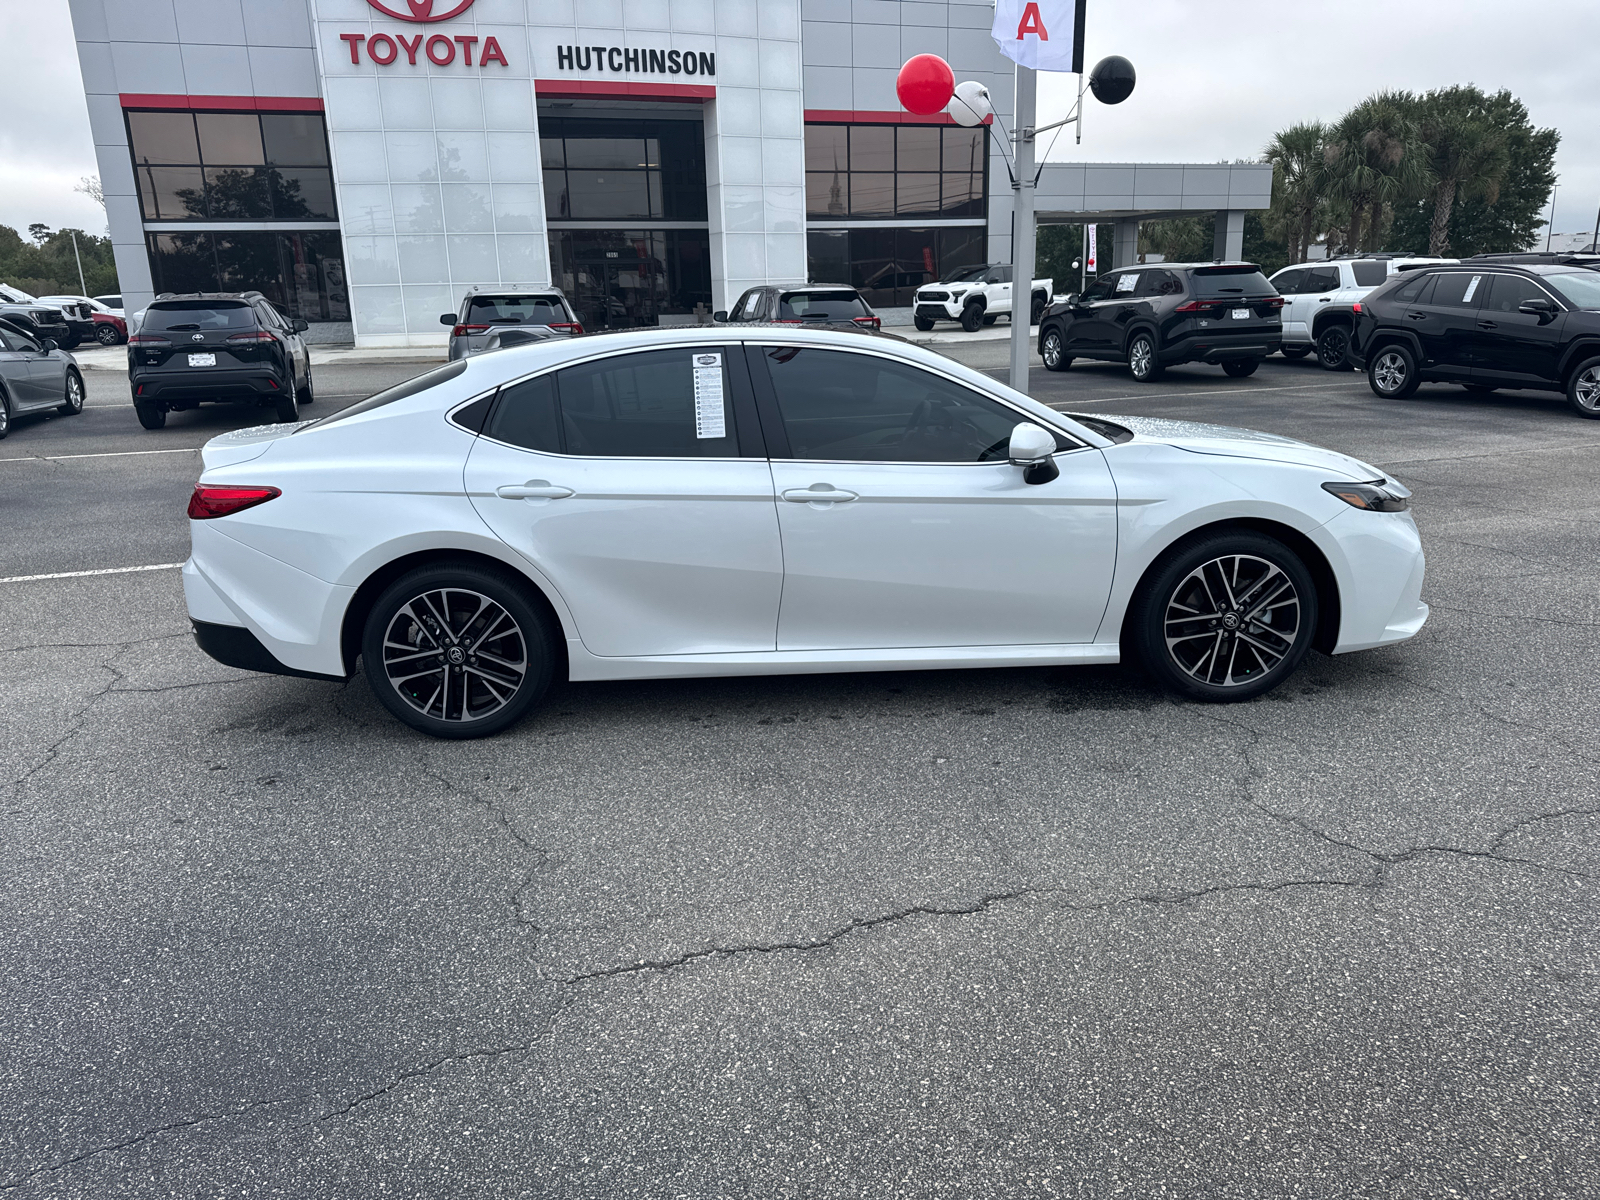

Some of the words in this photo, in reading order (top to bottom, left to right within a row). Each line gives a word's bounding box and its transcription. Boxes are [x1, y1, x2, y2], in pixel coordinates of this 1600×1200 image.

[1016, 2, 1049, 41] A
[339, 33, 509, 66] TOYOTA
[557, 45, 716, 76] HUTCHINSON
